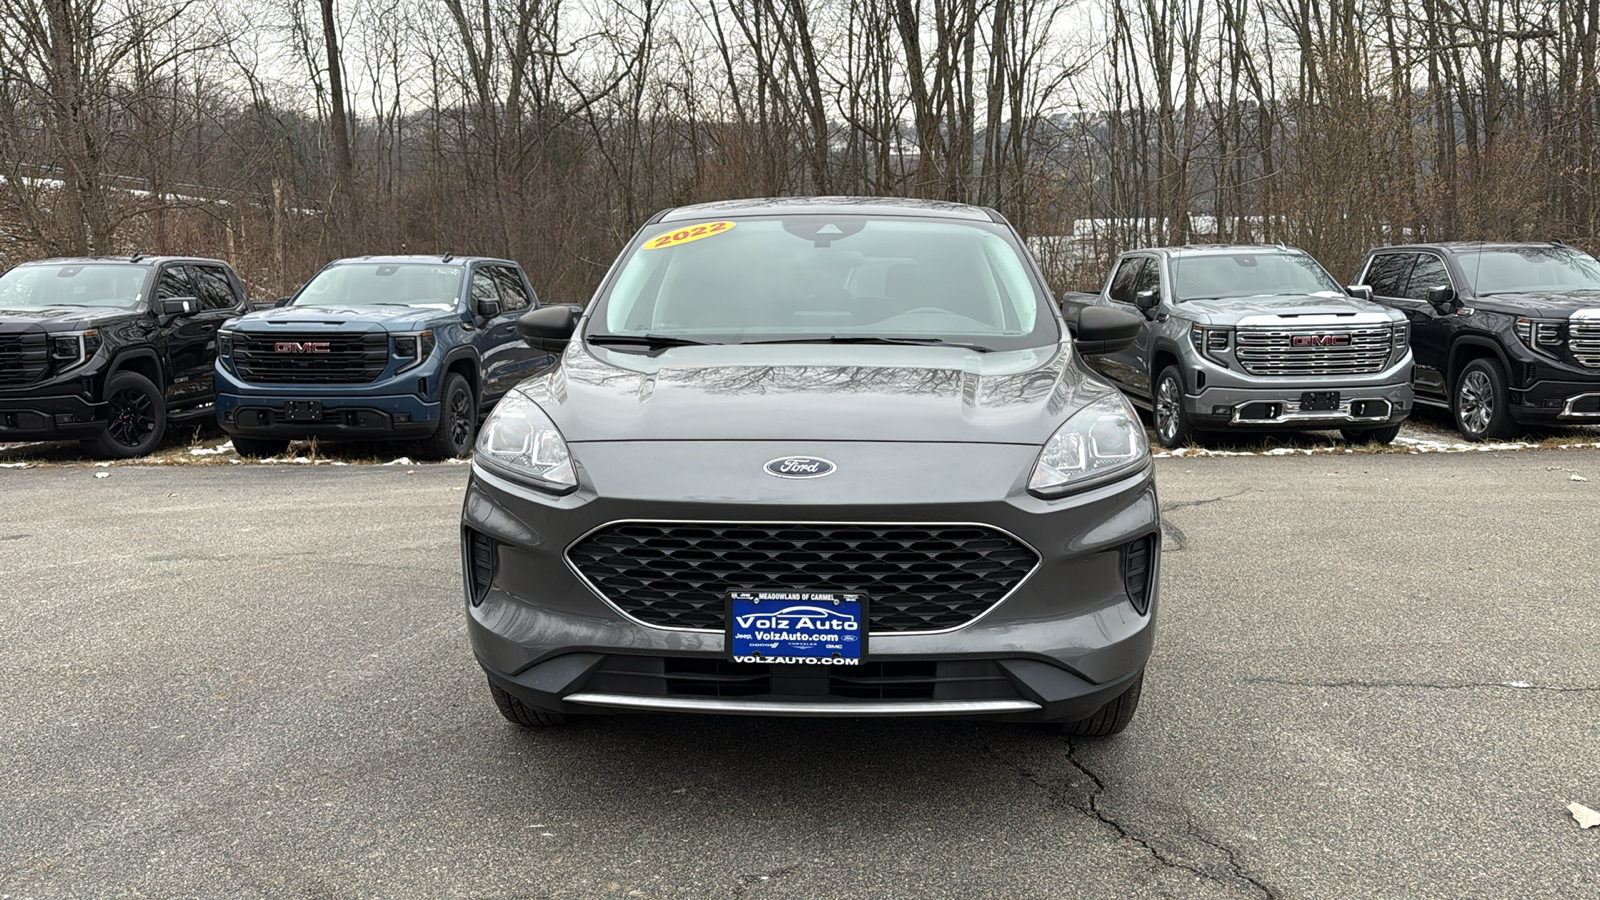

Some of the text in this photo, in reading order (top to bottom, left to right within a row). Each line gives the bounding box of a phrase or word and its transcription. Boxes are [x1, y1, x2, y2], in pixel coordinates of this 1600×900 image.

[654, 222, 727, 248] 2022
[1293, 335, 1350, 347] GMC
[274, 342, 331, 354] GMC
[780, 459, 820, 472] Ford
[810, 593, 835, 601] CARMEL
[735, 616, 858, 630] Volz Auto
[755, 631, 838, 641] VolzAuto.com
[733, 656, 859, 665] VOLZAUTO.COM
